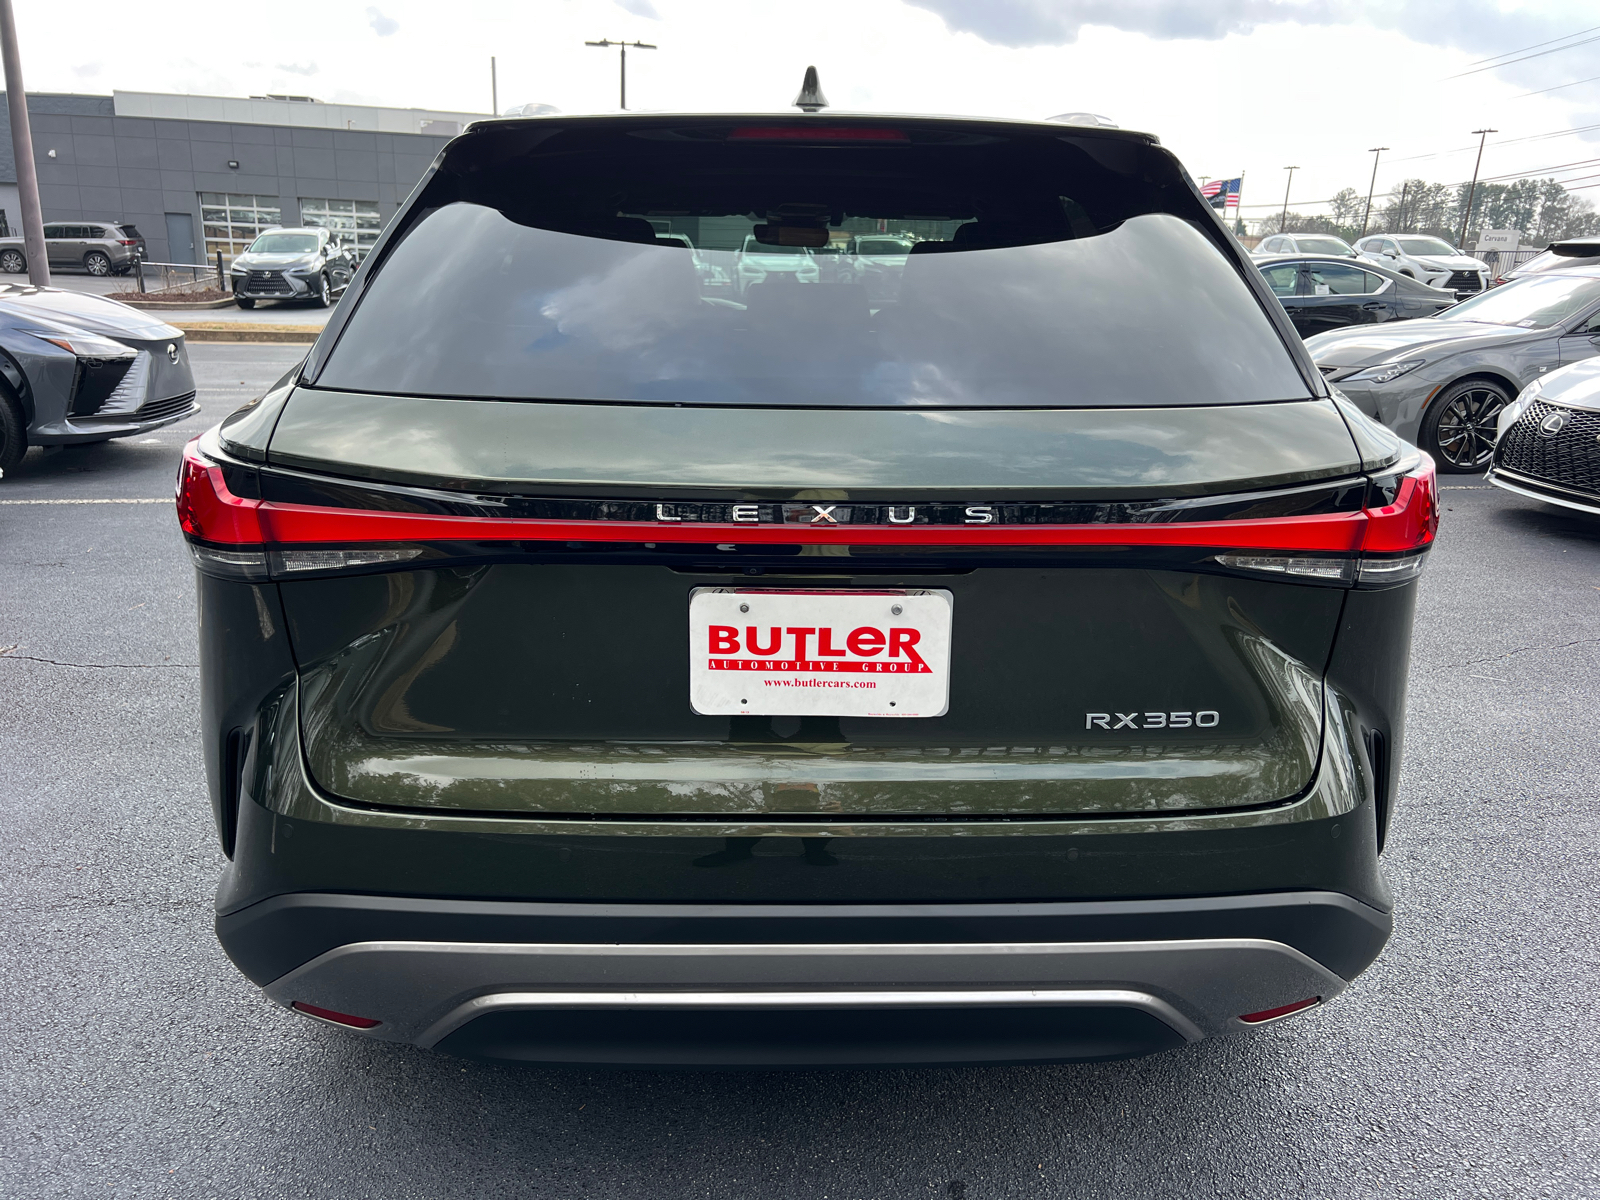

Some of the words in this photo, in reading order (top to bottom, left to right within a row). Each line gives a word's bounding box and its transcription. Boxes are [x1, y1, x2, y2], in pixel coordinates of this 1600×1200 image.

[656, 503, 993, 524] LEXUS
[709, 660, 839, 671] AUTOMOTIVE
[862, 662, 924, 672] GROUP
[763, 677, 877, 689] www.butlercars.com
